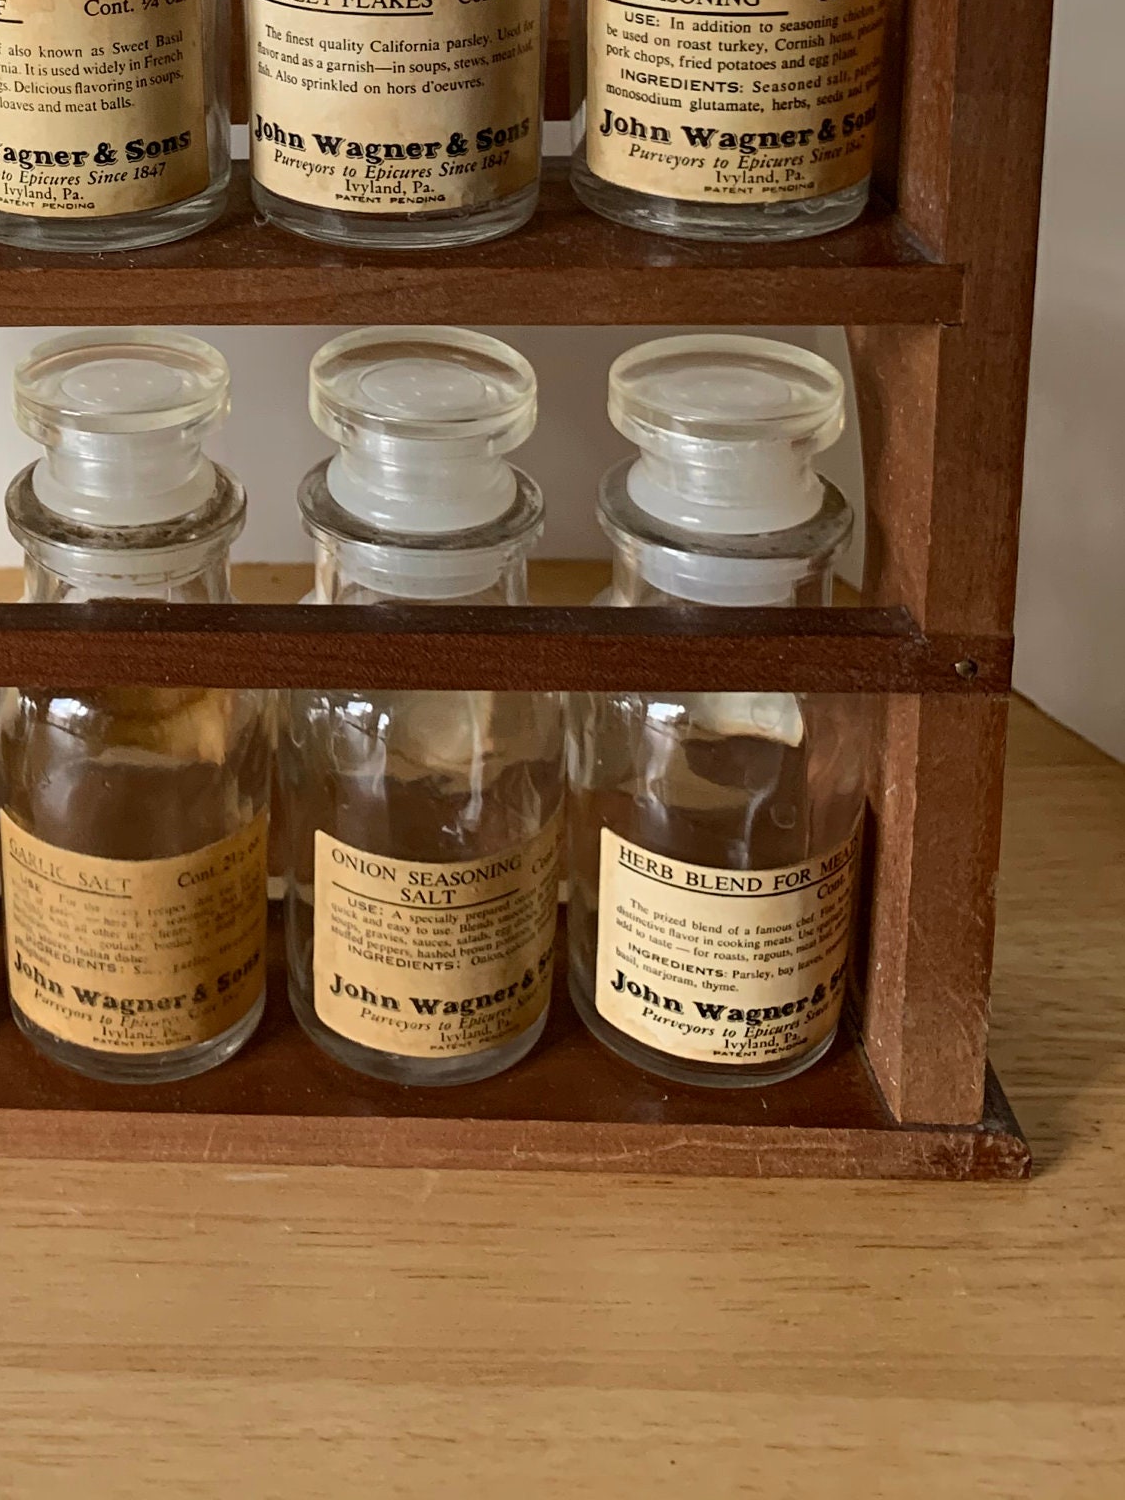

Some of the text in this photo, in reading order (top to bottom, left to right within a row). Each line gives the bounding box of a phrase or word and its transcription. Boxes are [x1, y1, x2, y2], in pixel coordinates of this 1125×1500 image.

[84, 0, 134, 16] Cont.
[625, 11, 839, 33] USE: In addition to seasoning
[265, 24, 493, 54] The finest quality California parsley.
[275, 71, 297, 84] Also
[301, 78, 357, 93] sprinkled
[364, 84, 381, 94] on
[387, 81, 416, 94] hors
[621, 68, 821, 93] INGREDIENTS: Seasoned
[0, 98, 34, 112] loaves
[38, 100, 61, 112] and
[65, 102, 97, 113] meat
[101, 98, 134, 111] balls.
[606, 82, 811, 112] monosodium glutamate, herbs,
[255, 114, 530, 165] John Wagner & Sons
[599, 108, 836, 155] John Wagner &
[93, 143, 117, 166] &
[125, 130, 191, 163] Sons
[9, 837, 131, 893] GARLIC SALT
[332, 848, 522, 887] ONION SEASONING
[619, 845, 811, 892] HERB BLEND FOR
[347, 897, 383, 915] USE:
[400, 888, 456, 905] SALT
[348, 944, 461, 971] INGREDIENTS:
[628, 943, 728, 978] INGREDIENTS:
[14, 950, 260, 1015] John Wagner & Sons
[329, 973, 517, 1017] John Wagner
[610, 969, 811, 1025] John Wagner
[642, 1007, 800, 1039] Purveyors to Epicures
